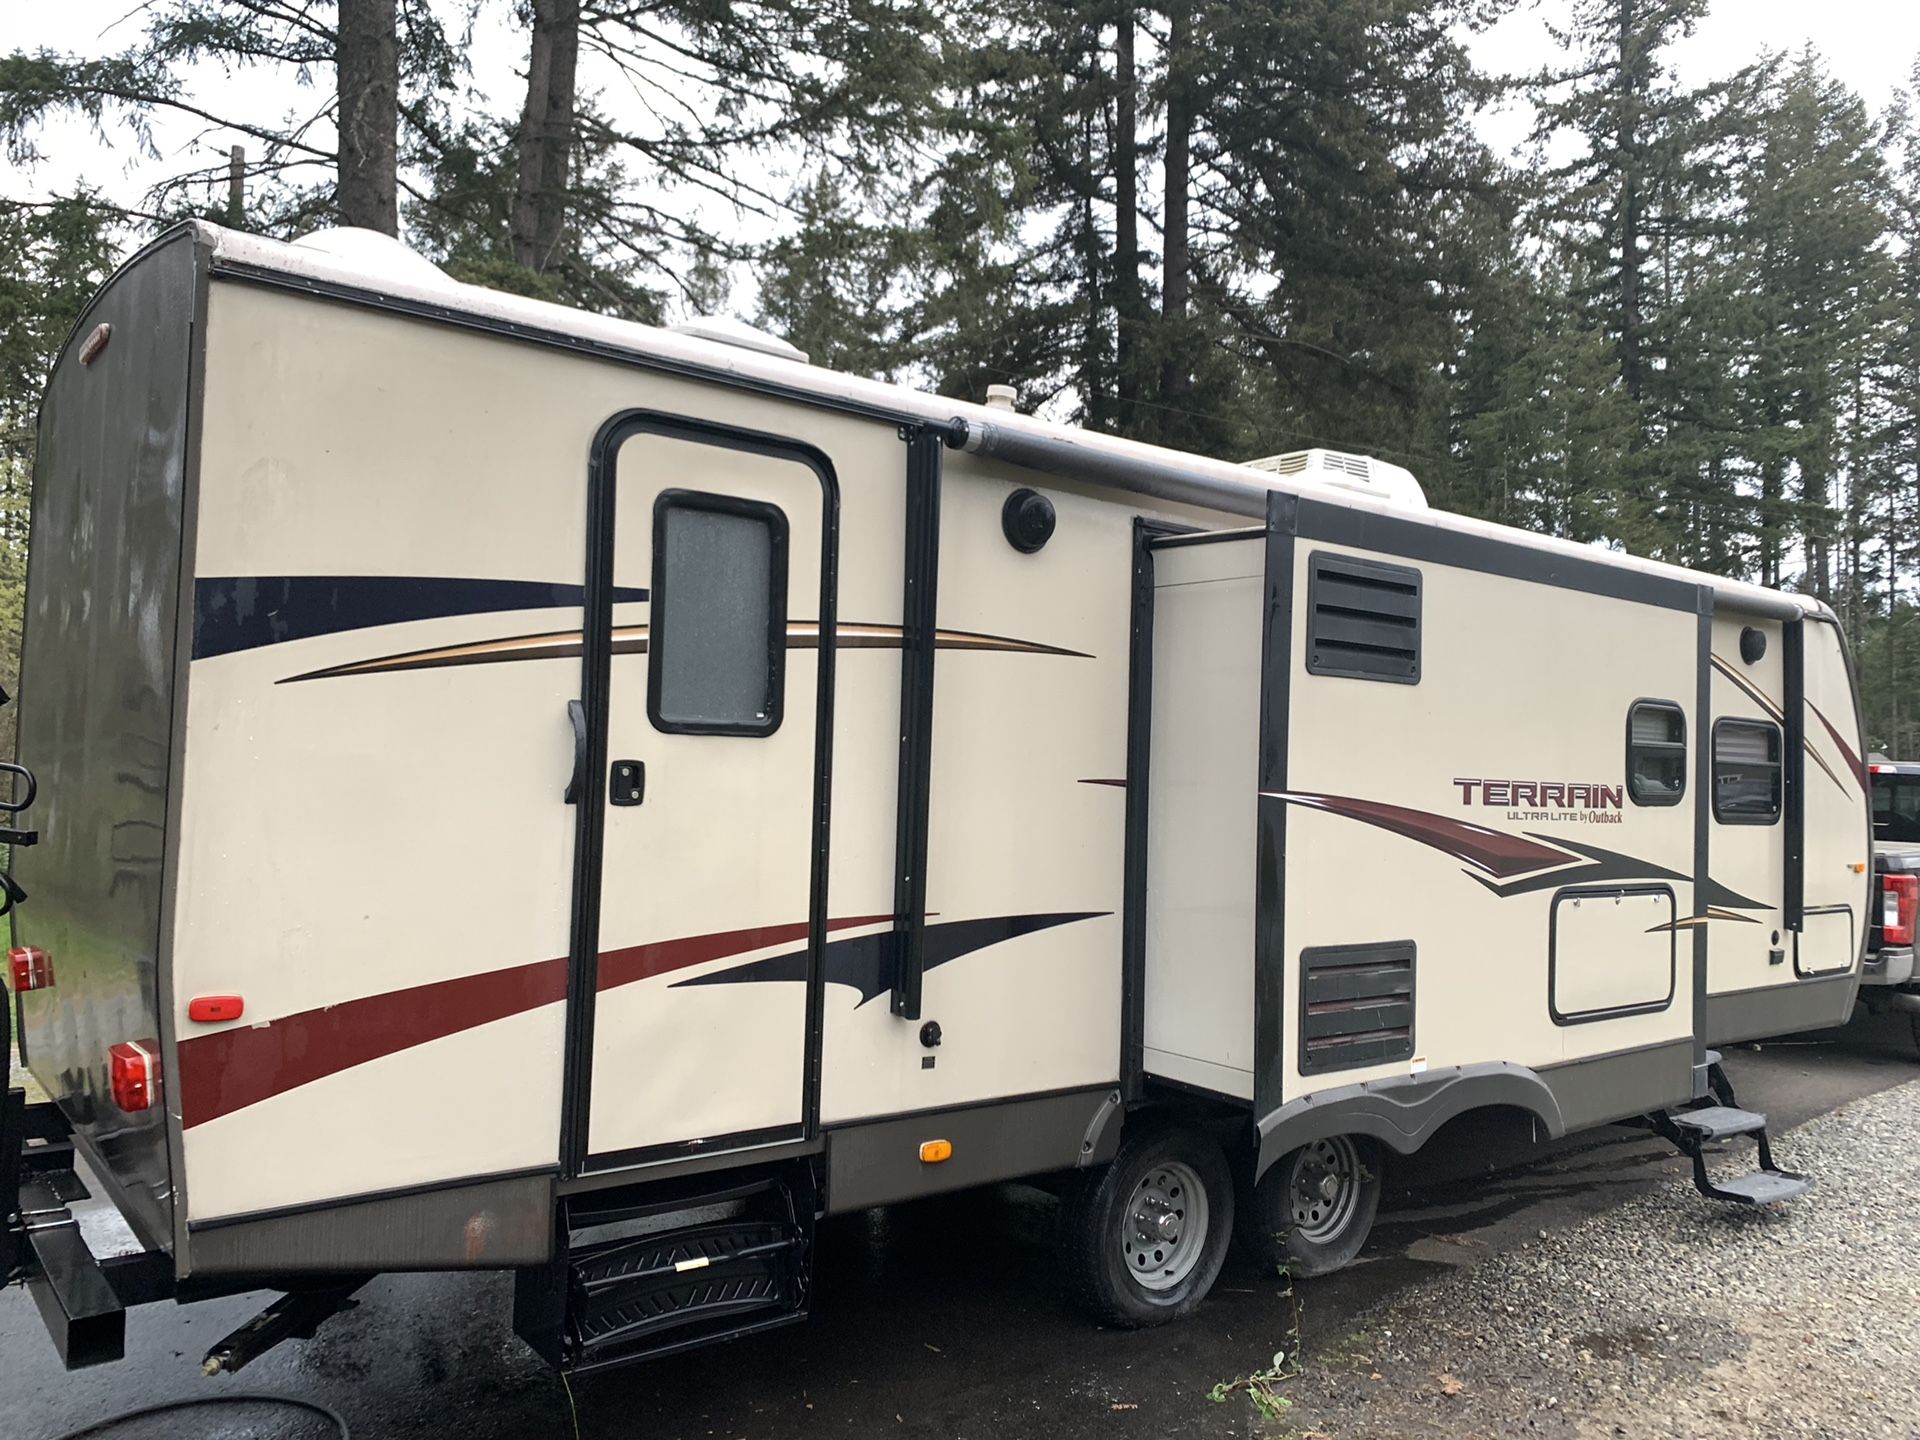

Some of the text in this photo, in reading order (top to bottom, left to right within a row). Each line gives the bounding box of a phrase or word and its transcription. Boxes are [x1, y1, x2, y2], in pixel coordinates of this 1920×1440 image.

[1453, 777, 1623, 809] TERRAIN
[1579, 811, 1588, 823] by
[1588, 810, 1623, 824] Outback
